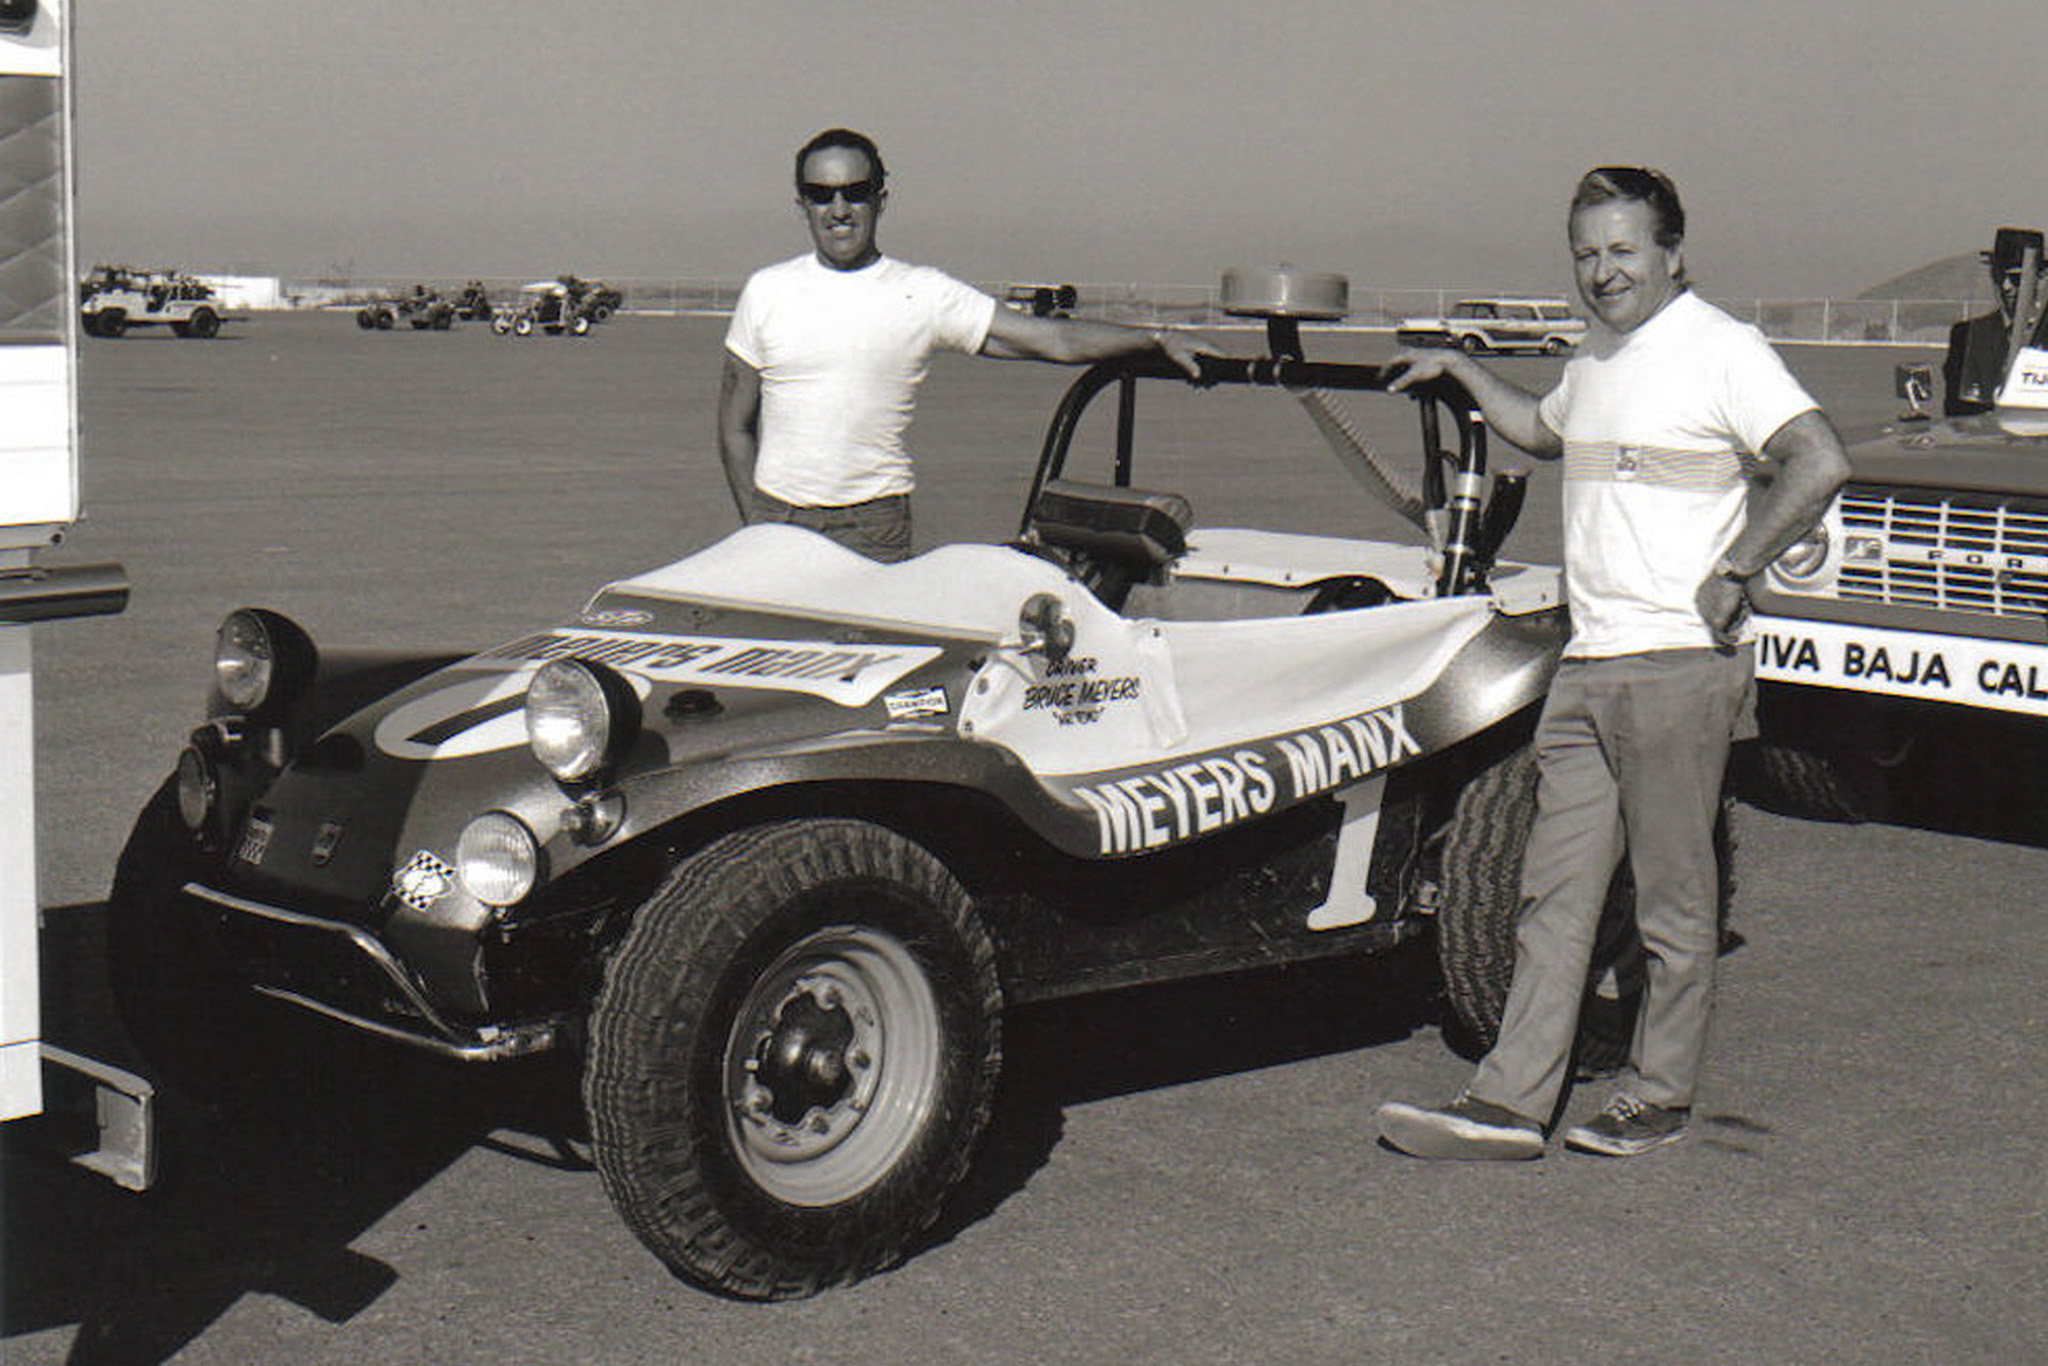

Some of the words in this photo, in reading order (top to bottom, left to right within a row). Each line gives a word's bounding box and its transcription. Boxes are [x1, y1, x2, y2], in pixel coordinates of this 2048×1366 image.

[1928, 551, 2023, 568] FOR
[1046, 657, 1097, 677] DRIVER
[1754, 633, 1820, 672] IVA
[1843, 643, 1951, 689] BAJA
[1978, 660, 2048, 699] CAL
[1023, 683, 1076, 711] BRUCE
[1078, 676, 1140, 705] MEYERS
[1072, 749, 1276, 855] MEYERS
[1274, 704, 1422, 798] MANX
[1307, 774, 1387, 932] 1
